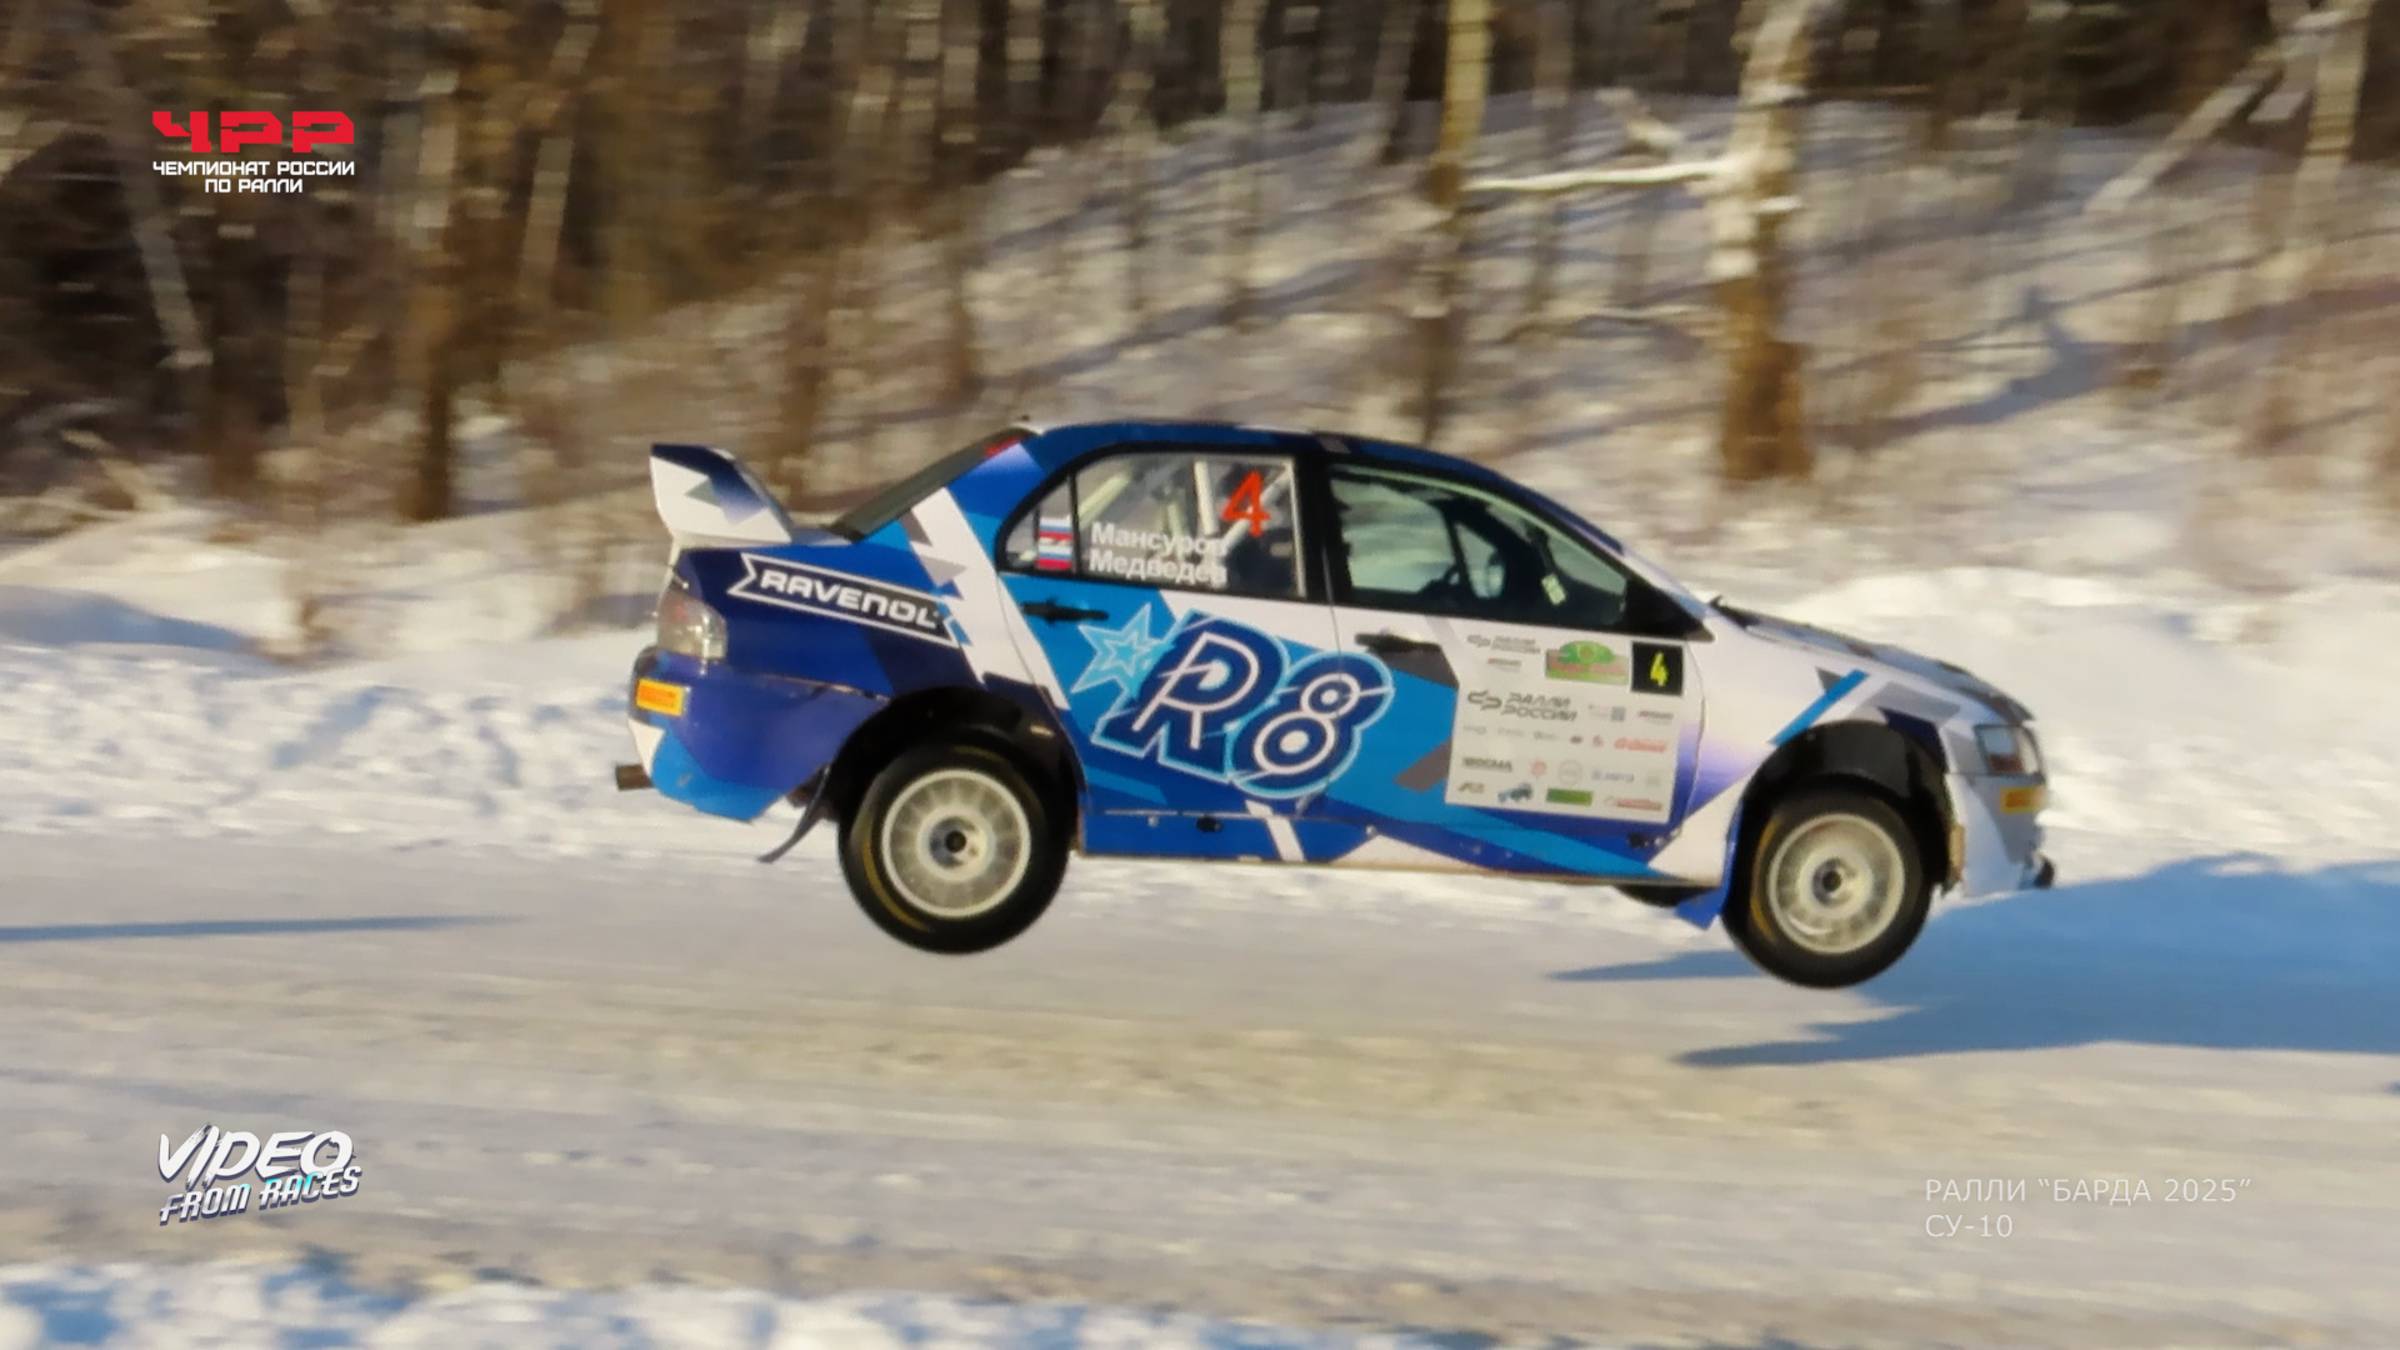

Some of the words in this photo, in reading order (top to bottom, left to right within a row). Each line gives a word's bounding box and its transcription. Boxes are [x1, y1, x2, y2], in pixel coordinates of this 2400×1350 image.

[1221, 470, 1271, 538] 4
[1090, 520, 1229, 556] Мансуров
[1089, 549, 1229, 589] Медведев
[759, 567, 940, 631] RAVENOL
[1650, 651, 1669, 687] 4
